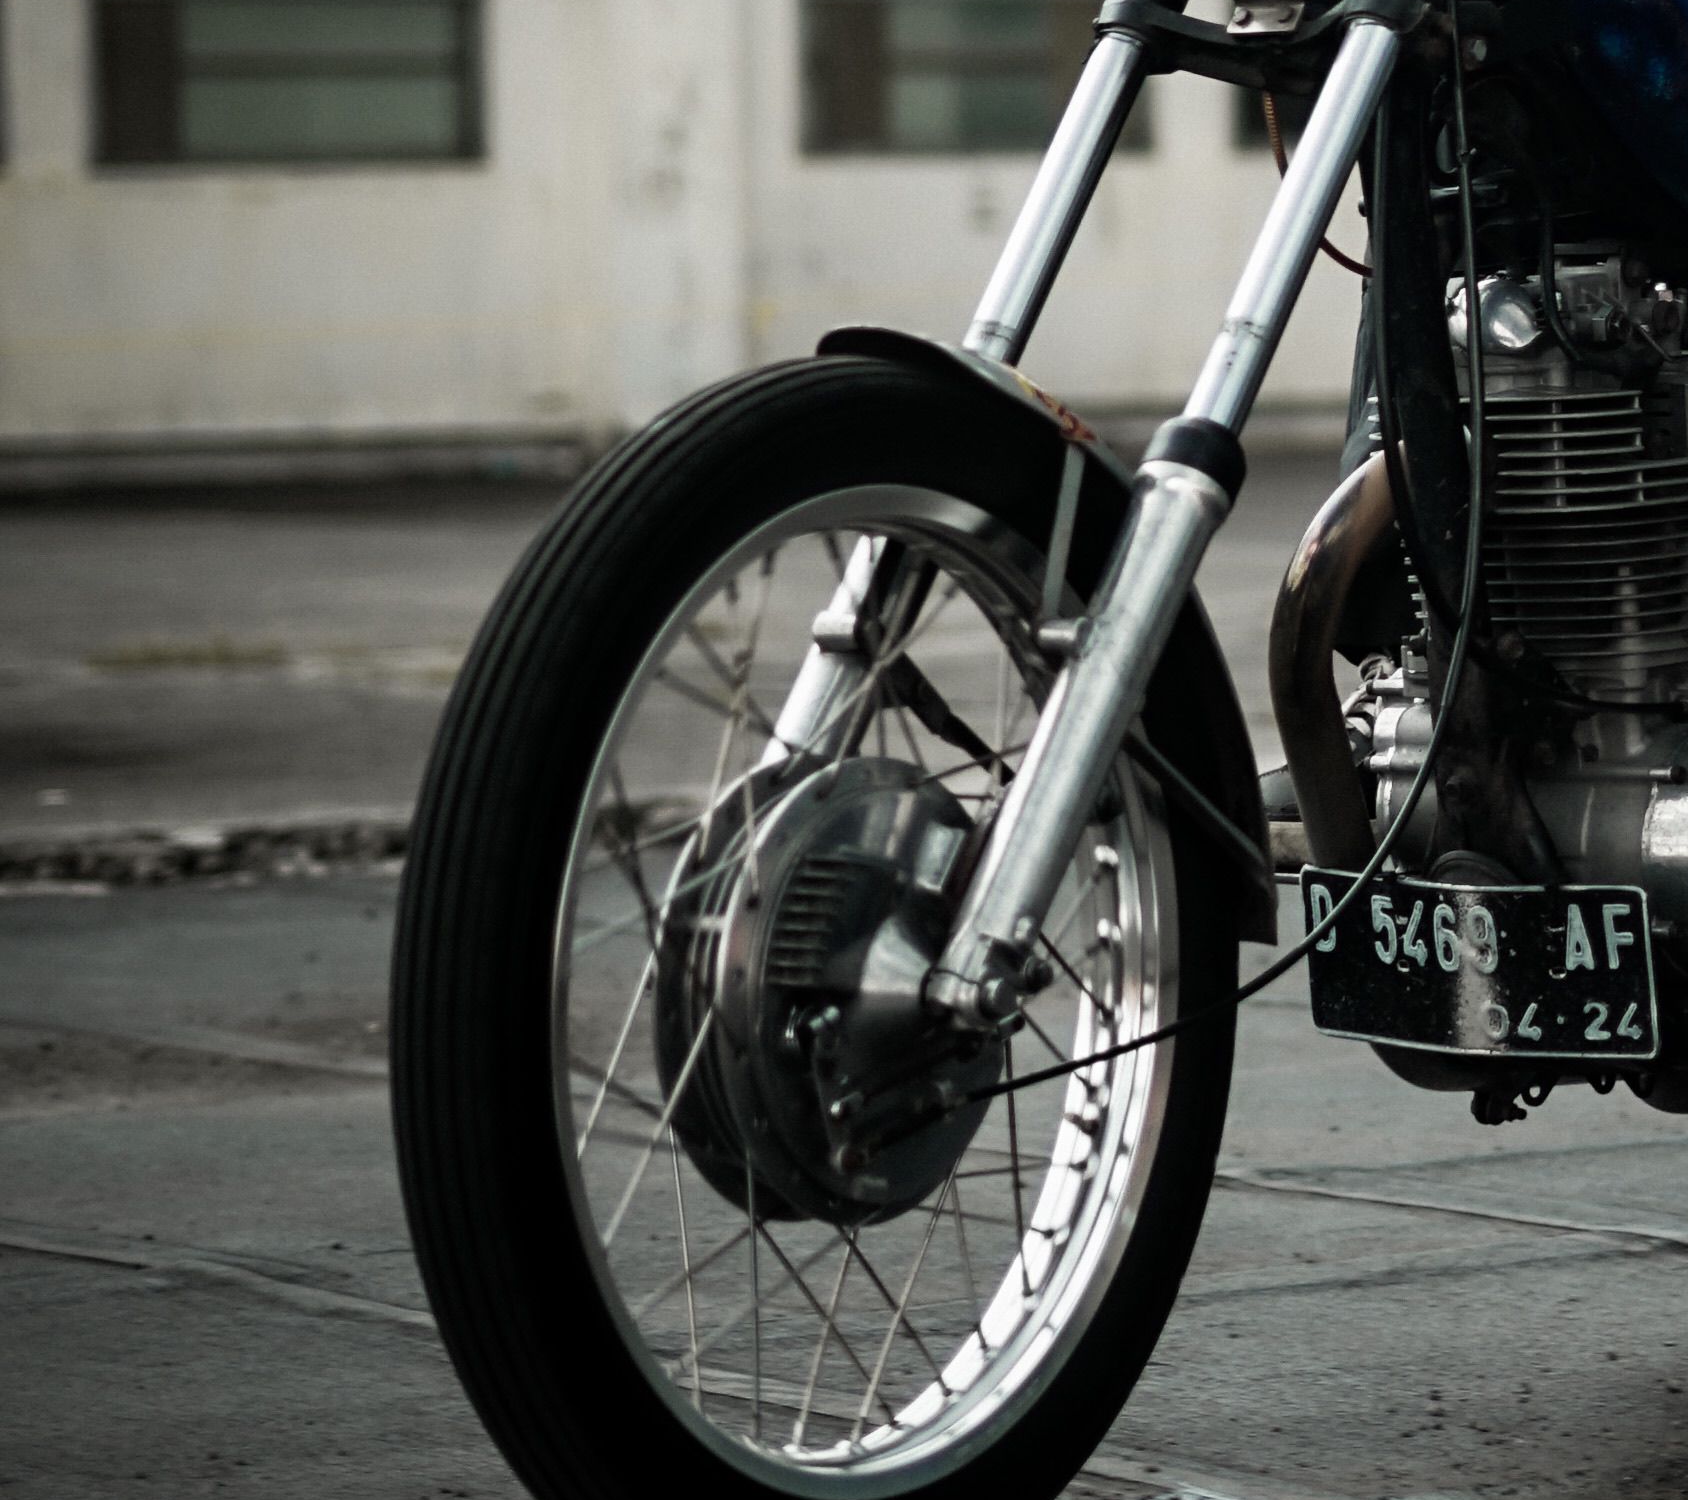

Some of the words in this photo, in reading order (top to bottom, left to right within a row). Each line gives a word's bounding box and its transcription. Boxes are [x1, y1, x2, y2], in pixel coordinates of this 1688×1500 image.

[1310, 884, 1337, 952] D
[1370, 895, 1499, 974] 5469
[1565, 904, 1634, 970] AF
